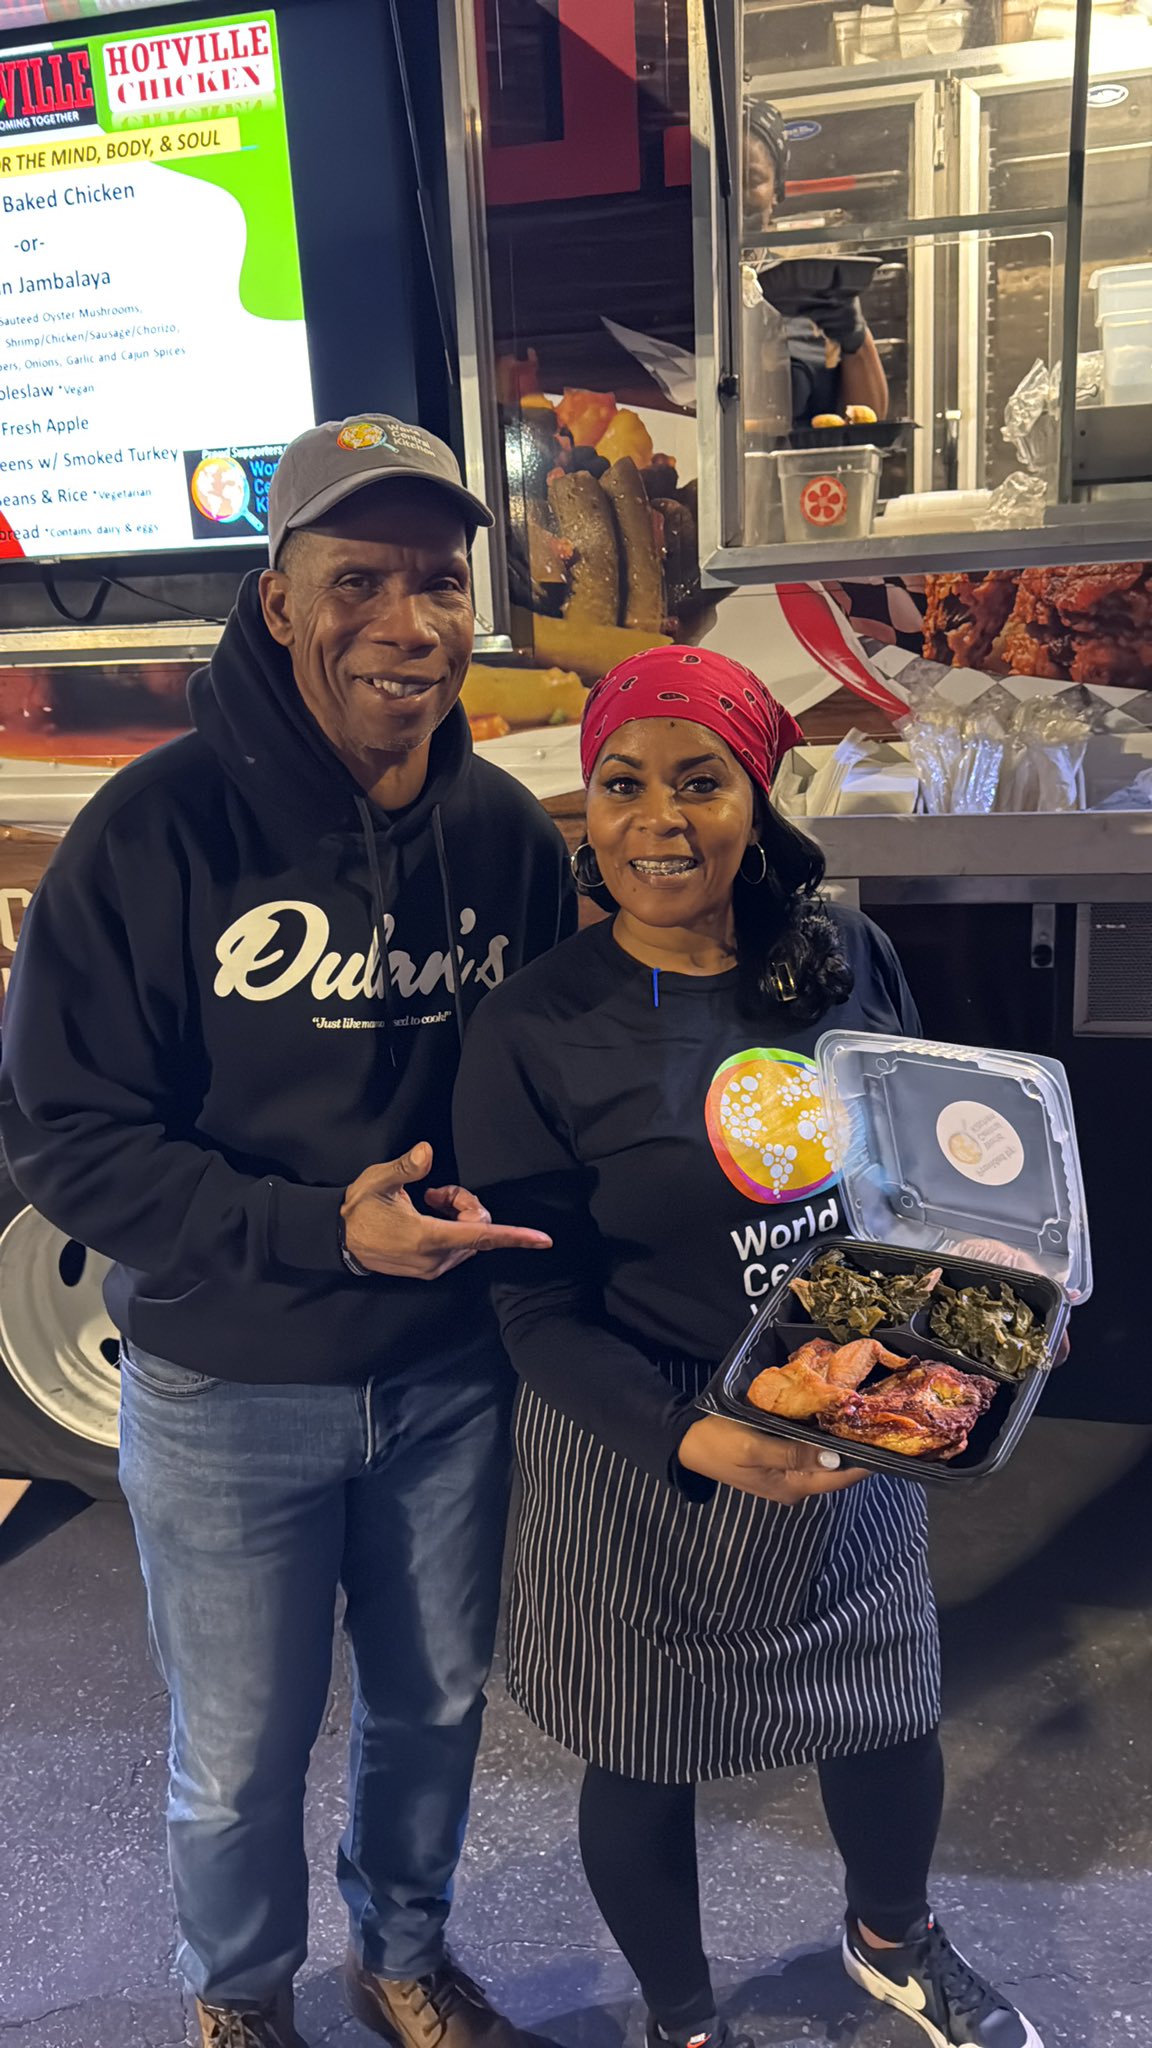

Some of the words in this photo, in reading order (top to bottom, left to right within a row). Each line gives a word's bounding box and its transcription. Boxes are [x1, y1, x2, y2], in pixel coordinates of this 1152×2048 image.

[106, 25, 269, 77] HOTVILLE
[117, 64, 260, 104] CHICKEN
[30, 110, 80, 127] TOGETHER
[16, 152, 46, 171] THE
[51, 145, 101, 166] MIND,
[106, 138, 152, 160] BODY,
[160, 135, 172, 153] &
[178, 129, 221, 149] SOUL
[4, 190, 58, 213] Baked
[64, 183, 135, 207] Chicken
[14, 238, 45, 252] -or-
[19, 269, 111, 294] Jambalaya
[43, 310, 75, 323] Oyster
[79, 305, 143, 318] Mushrooms,
[24, 358, 62, 369] Onions,
[66, 354, 95, 365] Garlic
[98, 351, 117, 362] and
[121, 349, 149, 361] Cajun
[153, 346, 186, 359] Spices
[2, 421, 41, 436] Fresh
[46, 416, 89, 434] Apple
[38, 451, 58, 471] w/
[63, 448, 123, 467] Smoked
[128, 446, 178, 463] Turkey
[248, 459, 280, 478] Wor
[41, 489, 53, 504] &
[58, 487, 88, 502] Rice
[97, 525, 121, 537] dairy
[125, 522, 133, 532] &
[136, 523, 159, 534] eggs
[342, 1017, 361, 1029] like
[393, 1015, 409, 1027] sed
[410, 1016, 420, 1026] to
[730, 1198, 839, 1261] World
